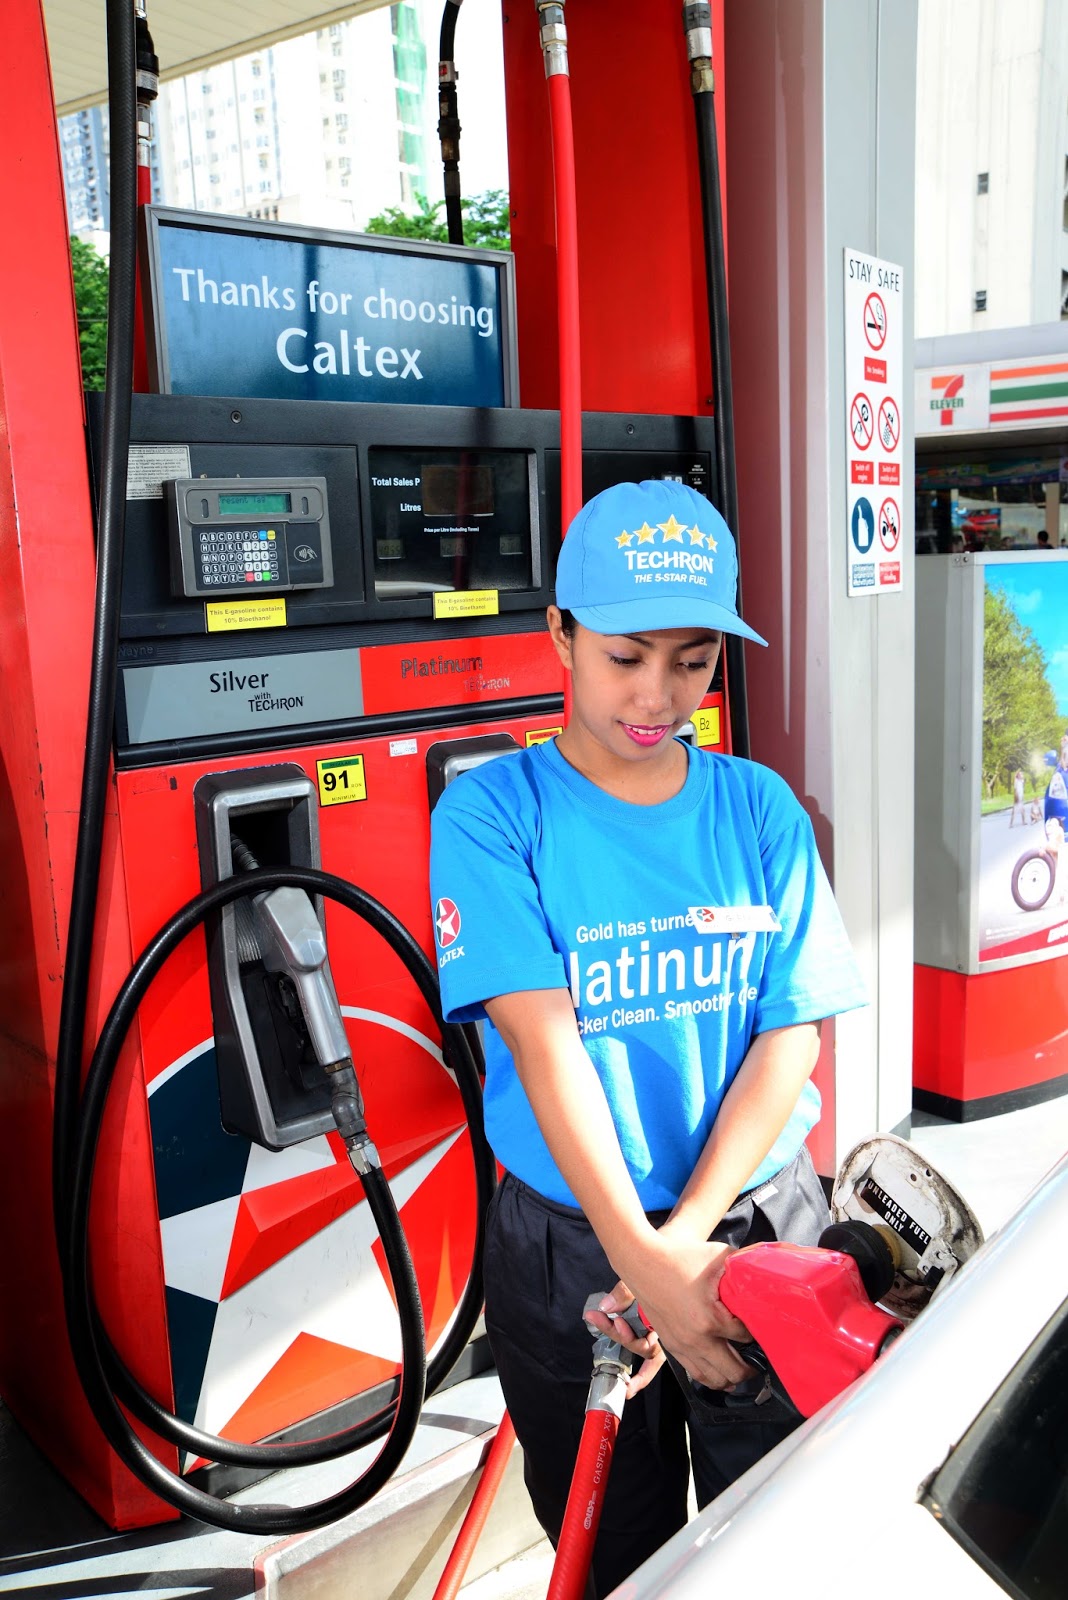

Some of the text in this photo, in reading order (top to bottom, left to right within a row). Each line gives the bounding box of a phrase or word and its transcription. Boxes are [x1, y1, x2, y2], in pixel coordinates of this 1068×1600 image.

[849, 259, 900, 292] STAY SAFE
[173, 268, 494, 338] Thanks for choosing
[276, 328, 424, 380] Caltex
[931, 374, 964, 426] 7
[372, 477, 420, 486] Total Sales P
[400, 503, 422, 512] Litres
[624, 550, 714, 574] TECHRON
[634, 572, 708, 586] THE 5-STAR FUEL
[400, 656, 483, 679] Platinum
[209, 670, 269, 693] Silver
[248, 696, 304, 712] TECHRON
[254, 692, 271, 700] with
[323, 770, 349, 791] 91
[576, 914, 694, 943] Gold has turne
[612, 1007, 660, 1028] Clean.
[868, 1180, 929, 1244] UNLEADED FUEL
[884, 1211, 904, 1232] ONLY
[593, 1436, 608, 1484] GASFLEX
